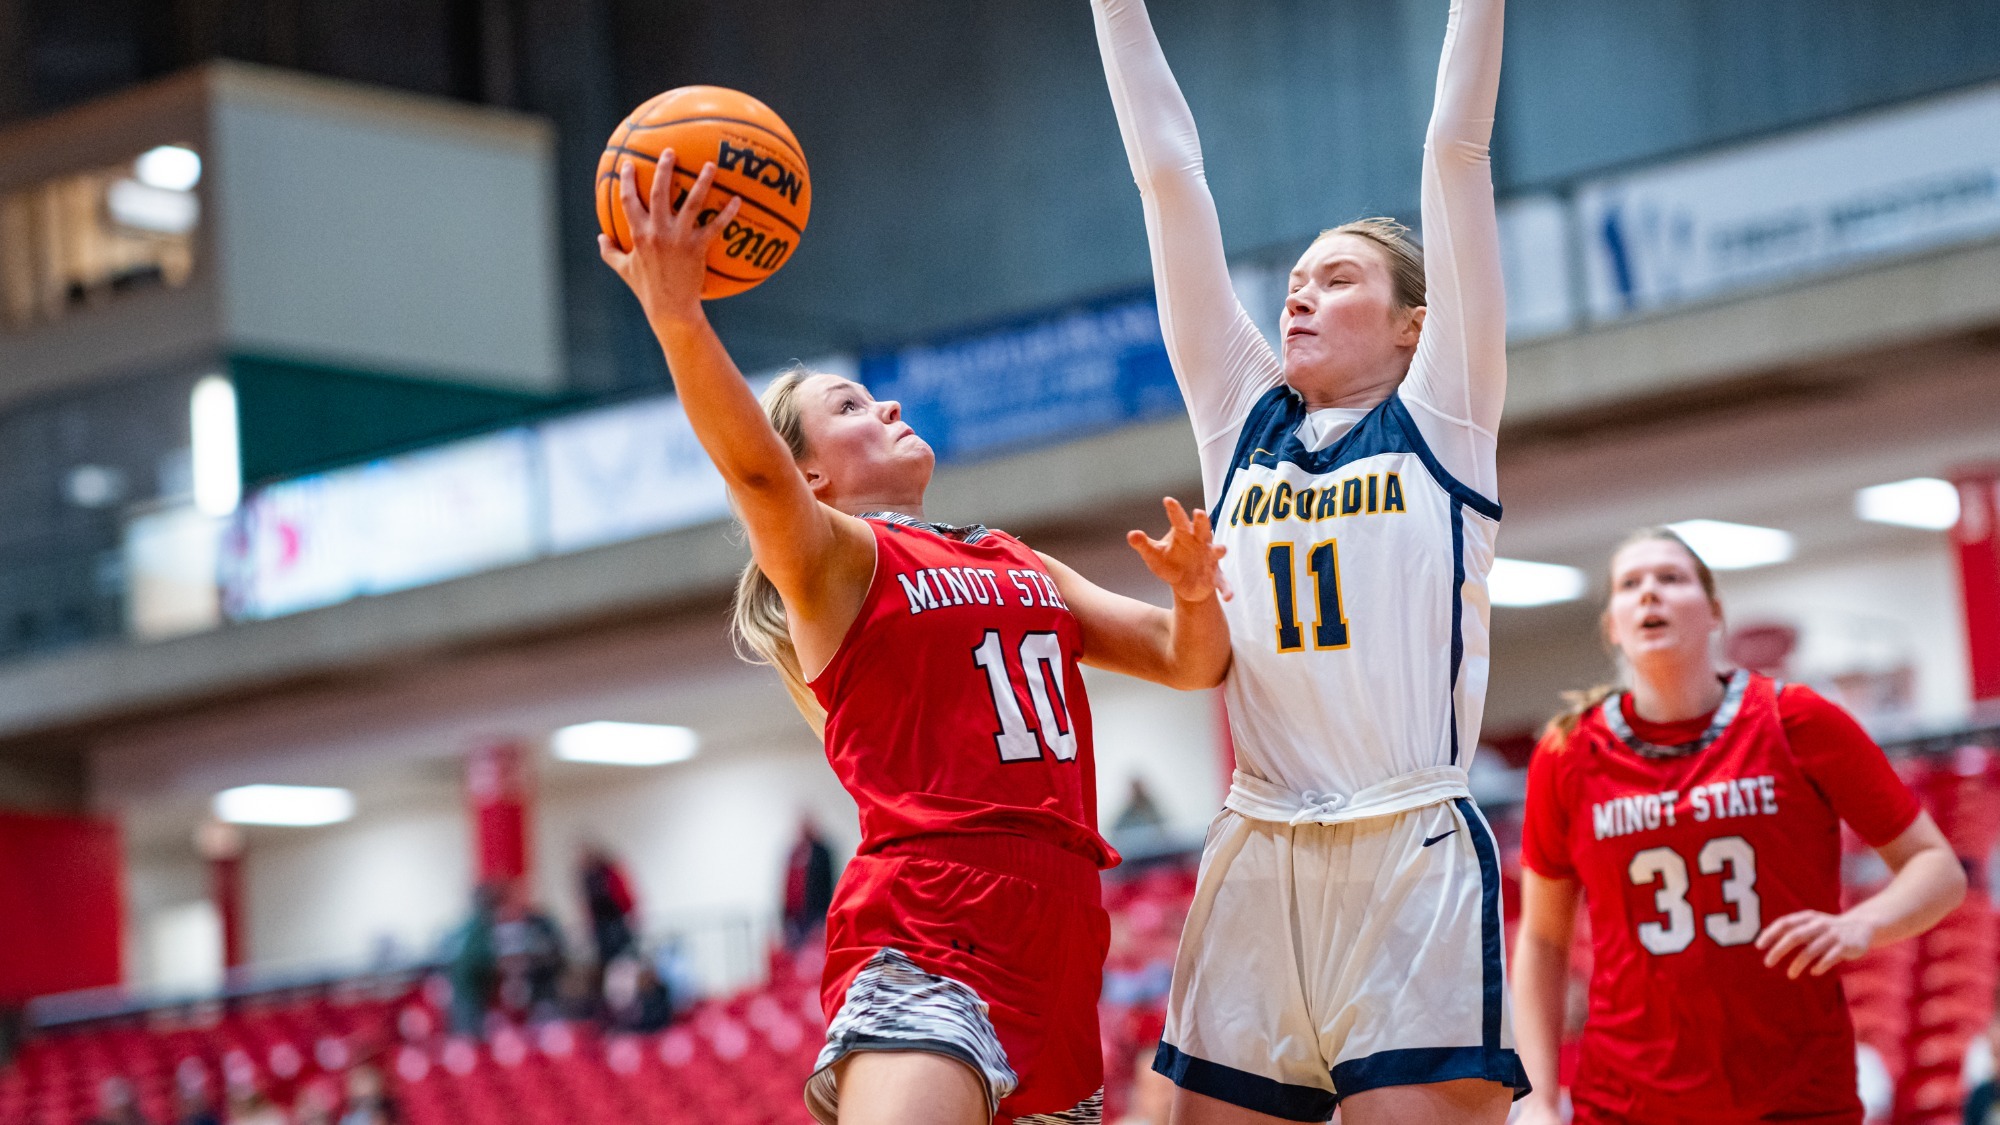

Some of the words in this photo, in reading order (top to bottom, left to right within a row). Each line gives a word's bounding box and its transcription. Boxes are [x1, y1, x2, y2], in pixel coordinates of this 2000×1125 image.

[718, 141, 803, 206] NCAA
[897, 566, 1005, 615] MINOT
[1266, 538, 1351, 654] 11
[971, 628, 1078, 764] 10
[1592, 790, 1679, 840] MINOT
[1690, 775, 1779, 822] STATE
[1628, 835, 1762, 955] 33
